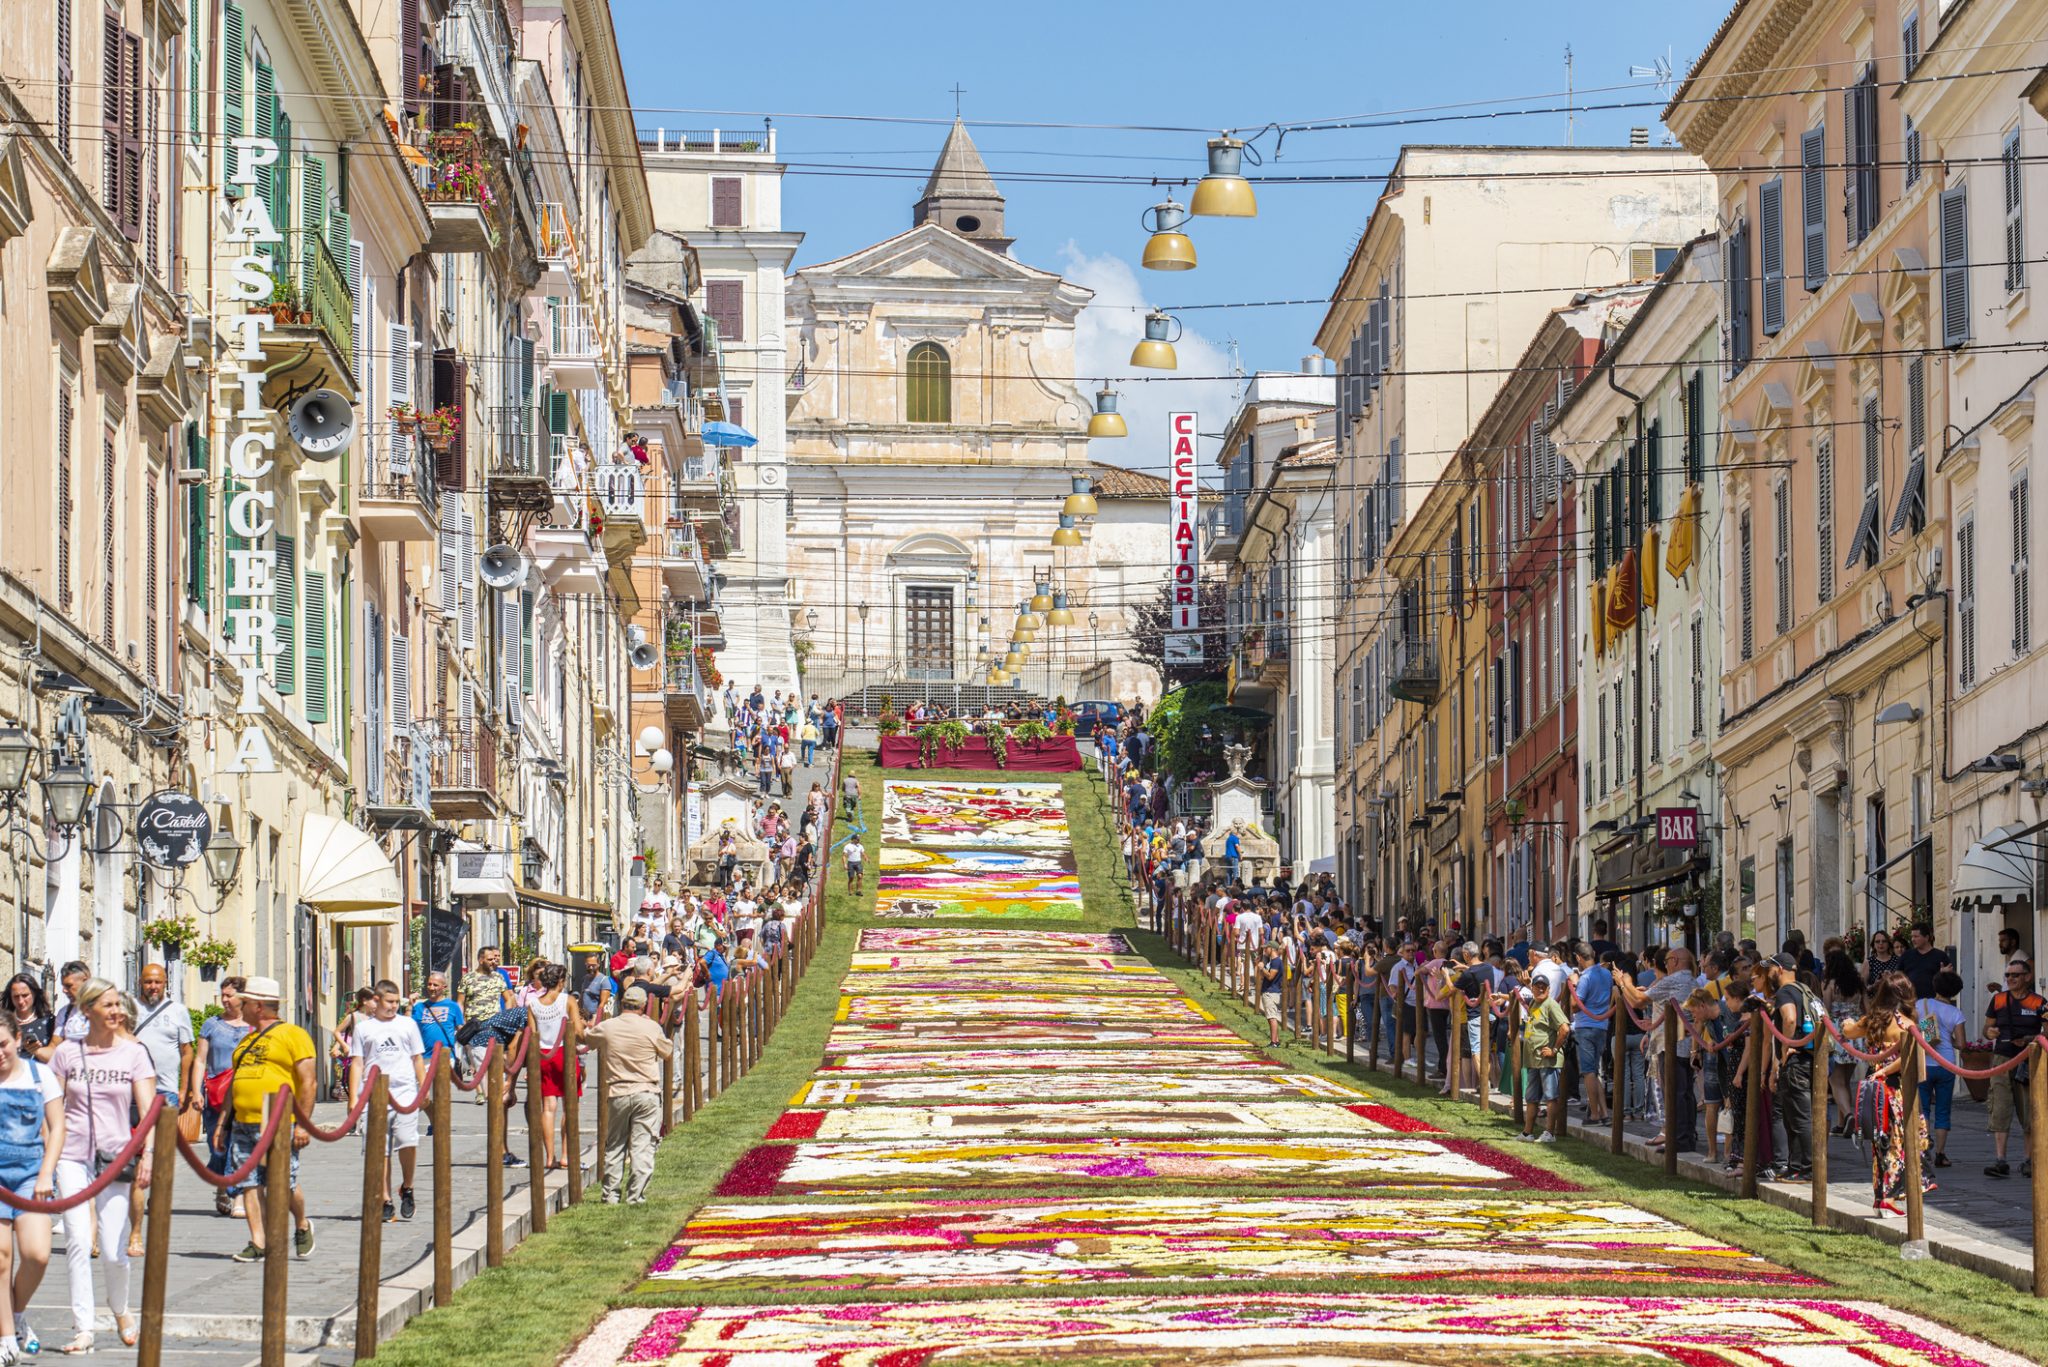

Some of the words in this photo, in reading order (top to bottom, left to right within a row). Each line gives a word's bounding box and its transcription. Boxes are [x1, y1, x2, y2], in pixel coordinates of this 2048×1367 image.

[225, 137, 285, 772] PASTICCERIA
[1174, 415, 1194, 627] CACCIATORI
[150, 808, 207, 828] Castelli
[1661, 816, 1694, 840] BAR
[67, 1066, 130, 1084] AMORE
